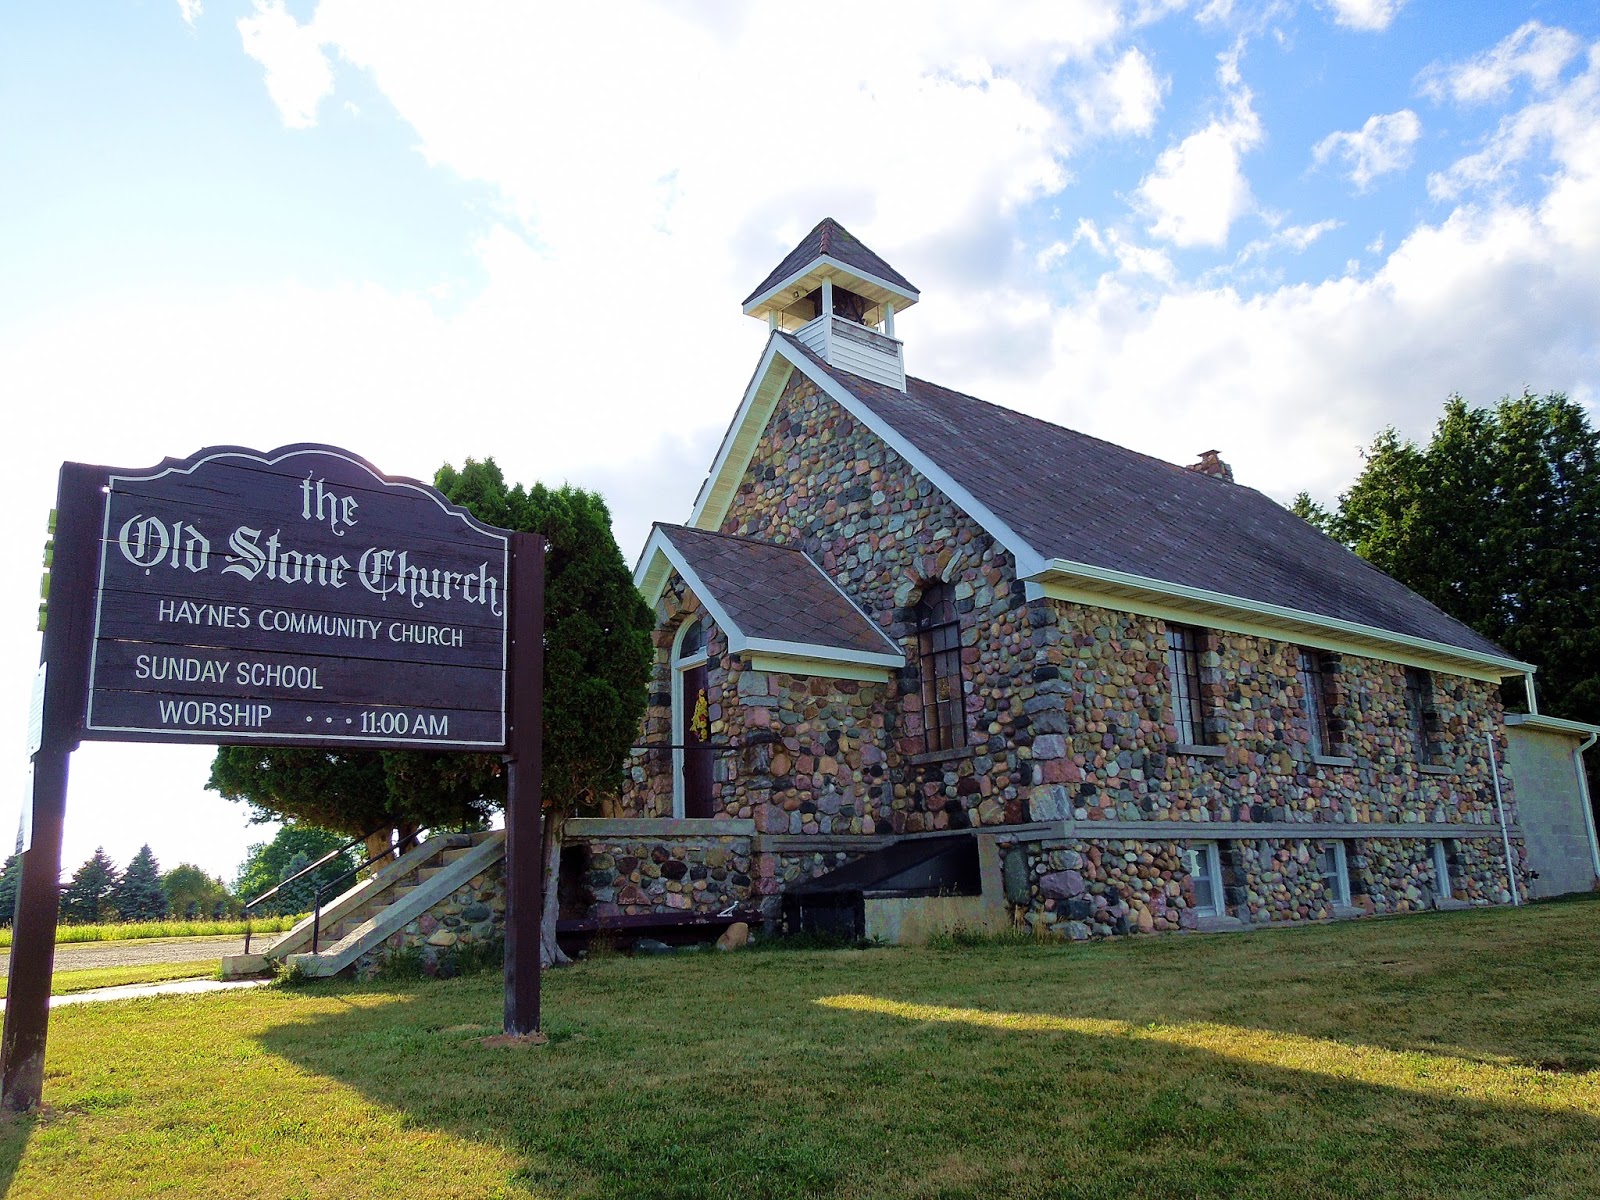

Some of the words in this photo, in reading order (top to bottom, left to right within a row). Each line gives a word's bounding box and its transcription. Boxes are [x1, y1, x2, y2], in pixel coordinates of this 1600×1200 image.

[299, 469, 358, 536] the
[118, 514, 210, 575] Old
[221, 526, 349, 588] Stone
[358, 547, 503, 617] Church
[158, 600, 251, 629] HAYNES
[258, 609, 382, 640] COMMUNITY
[388, 623, 463, 648] CHURCH
[135, 654, 231, 684] SUNDAY
[236, 662, 323, 690] SCHOOL
[159, 700, 272, 727] WORSHIP
[360, 711, 409, 735] 11:00
[413, 715, 448, 736] AM
